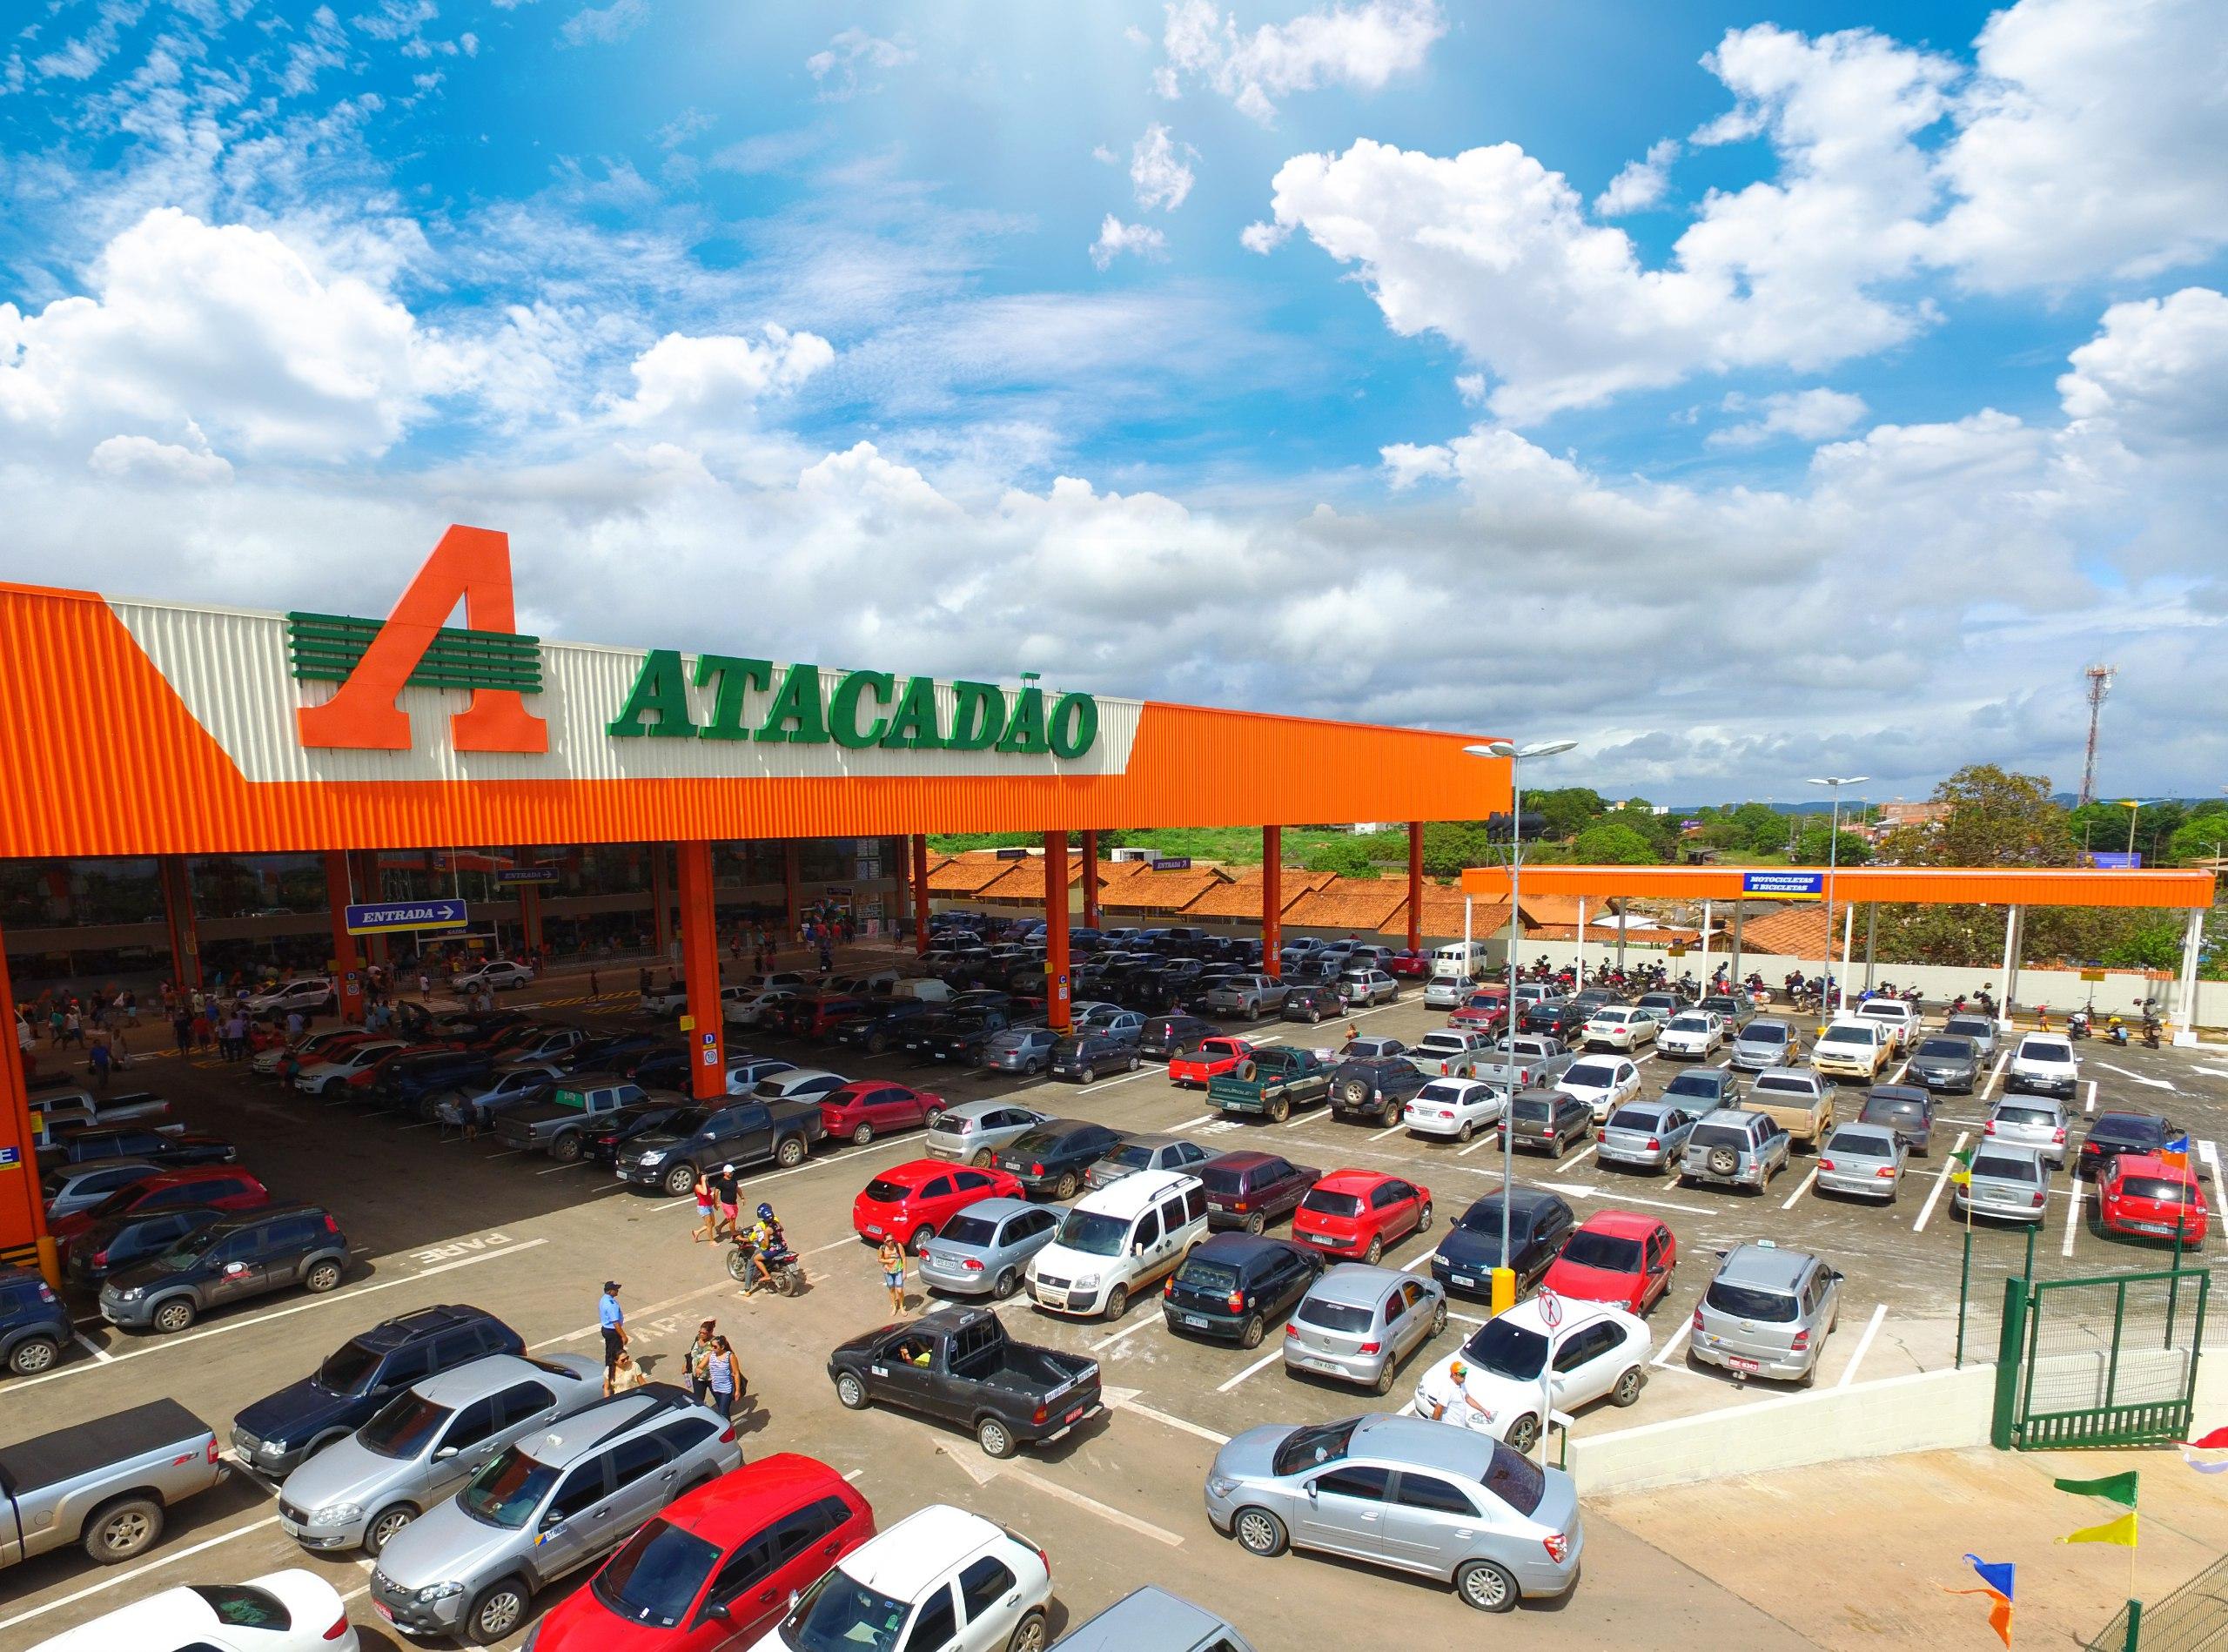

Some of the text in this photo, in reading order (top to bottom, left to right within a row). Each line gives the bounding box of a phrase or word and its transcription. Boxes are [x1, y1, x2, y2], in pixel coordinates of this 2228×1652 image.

[297, 524, 549, 753] A
[606, 649, 1098, 759] ATACADÃO
[362, 908, 434, 923] ENTRADA
[705, 1034, 714, 1044] D
[1215, 1085, 1255, 1096] CHEVROLET
[0, 1148, 14, 1164] E
[409, 1232, 513, 1264] PARE
